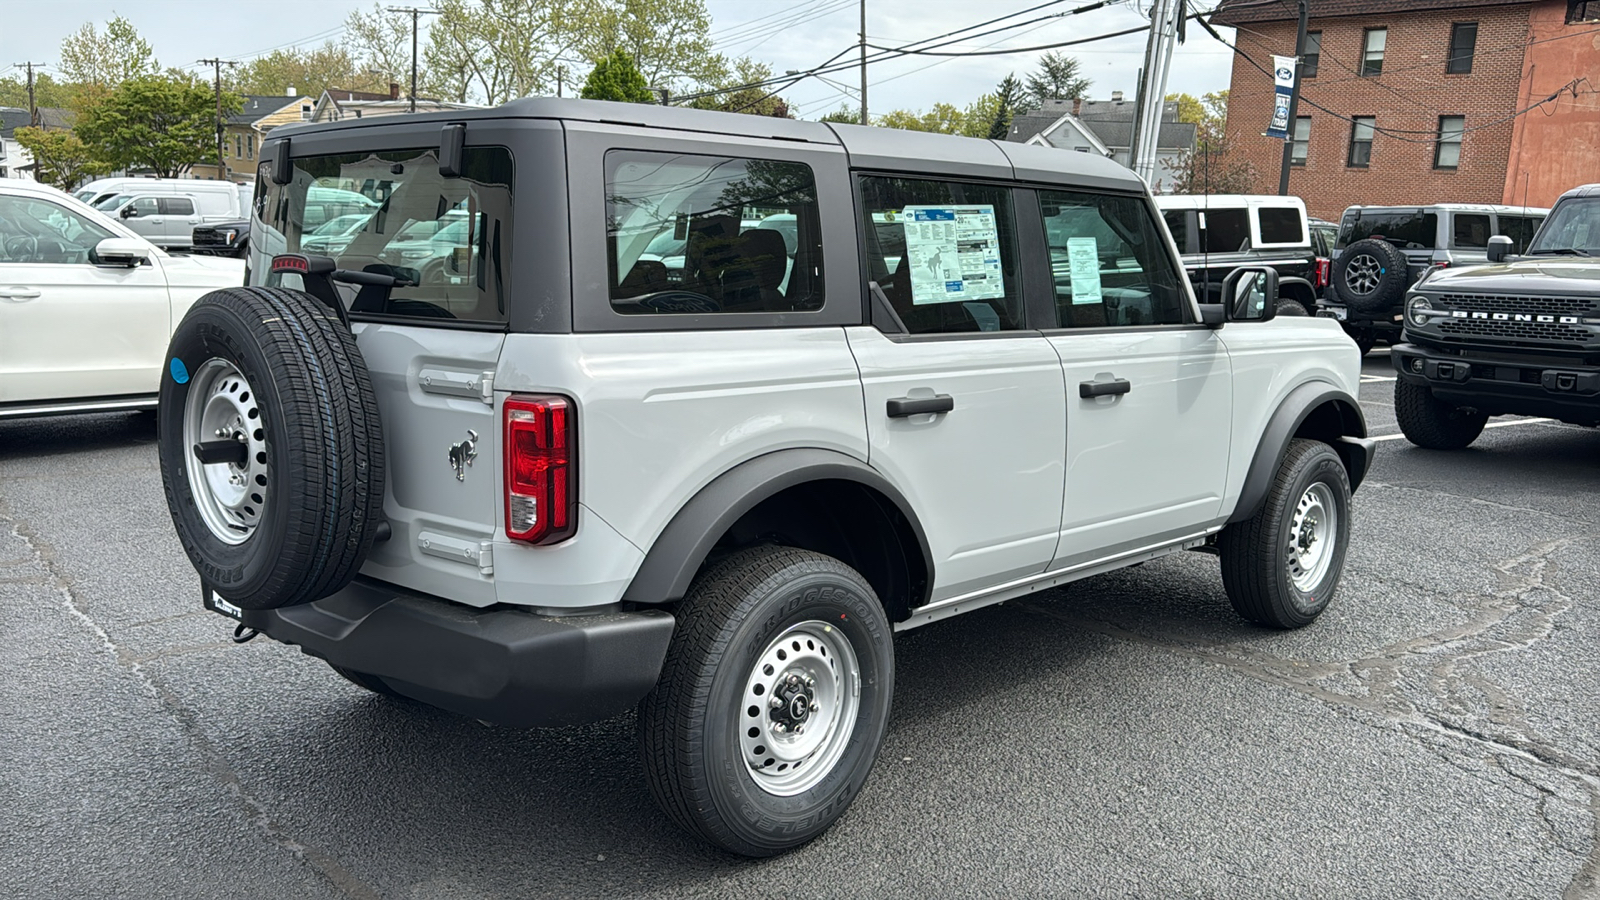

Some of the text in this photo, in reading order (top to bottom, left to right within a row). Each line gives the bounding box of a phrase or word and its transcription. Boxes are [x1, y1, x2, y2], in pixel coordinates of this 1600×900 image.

[1278, 68, 1291, 80] Ford
[1452, 310, 1578, 324] BRONCO
[747, 586, 884, 655] BRIDGESTONE
[740, 783, 852, 835] DUELER
